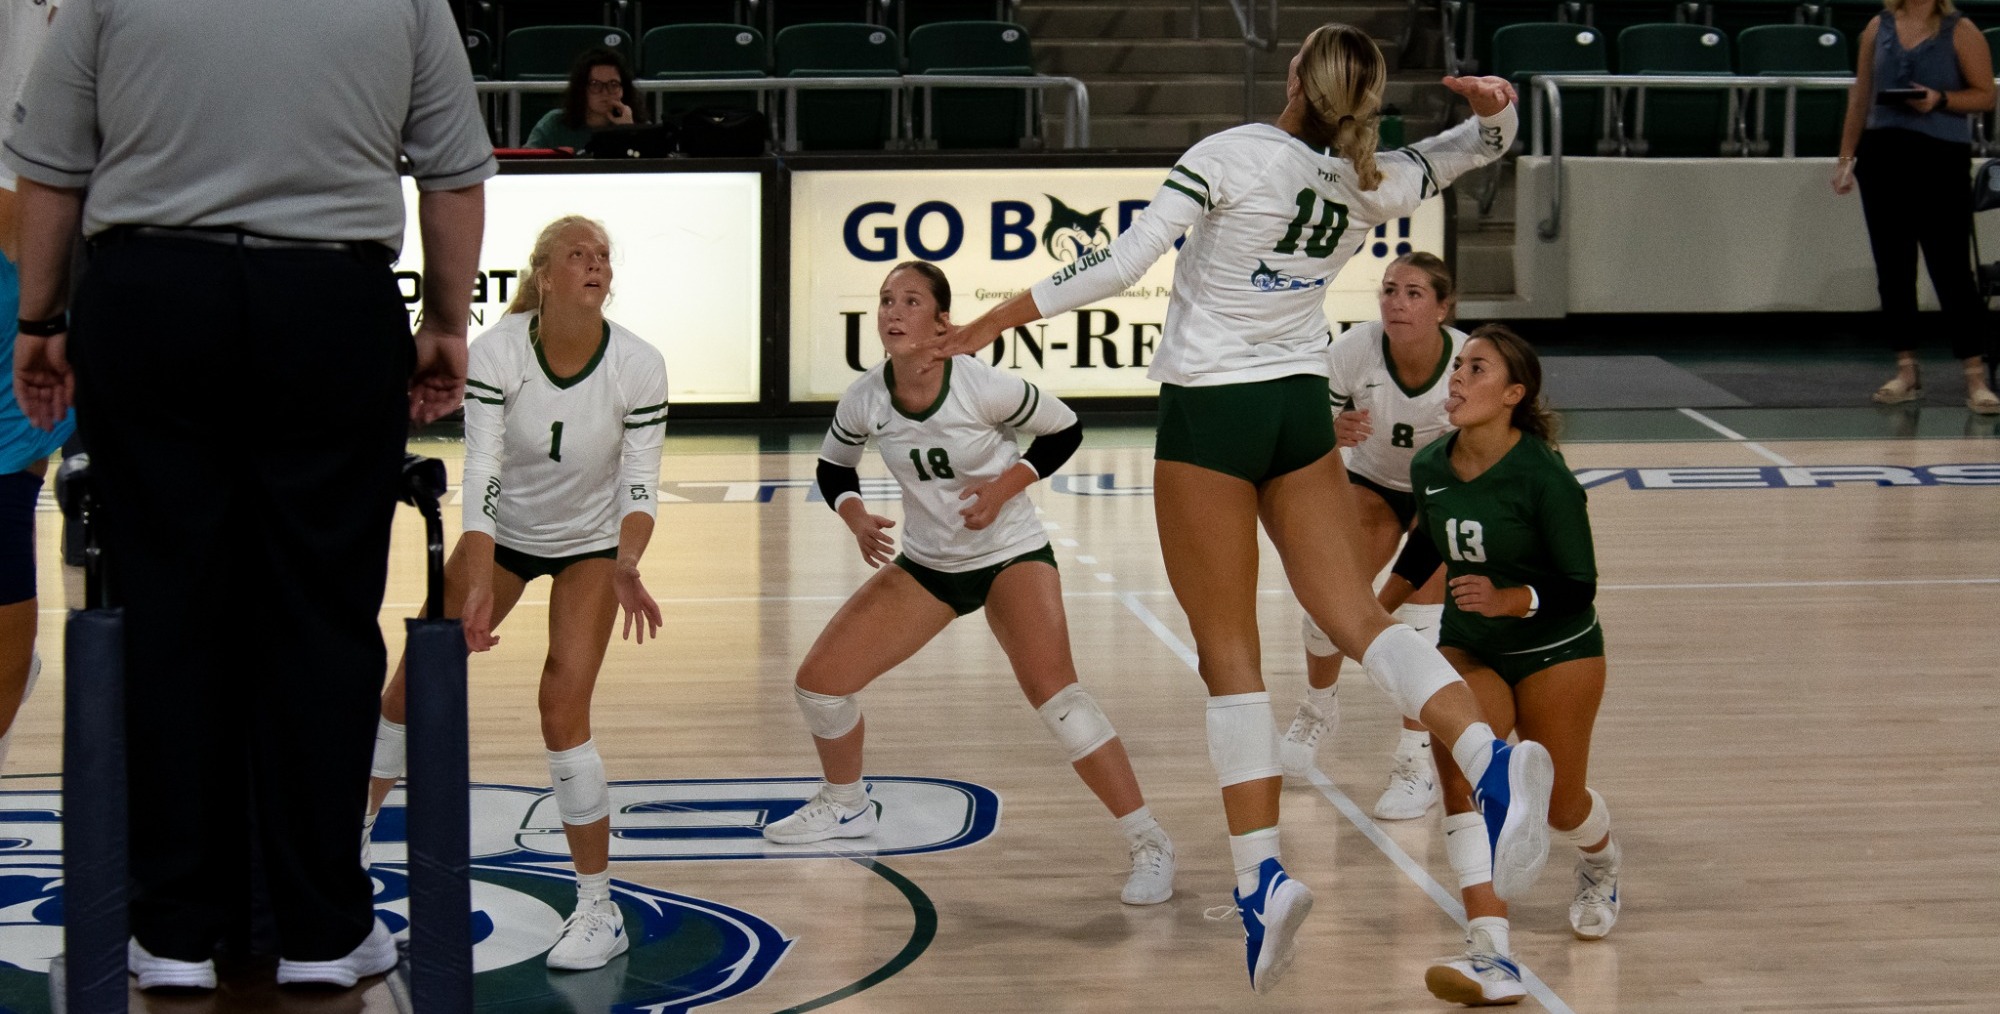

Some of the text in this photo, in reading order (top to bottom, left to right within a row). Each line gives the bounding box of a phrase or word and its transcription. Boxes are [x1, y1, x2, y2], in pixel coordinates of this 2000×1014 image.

[843, 200, 965, 262] GO
[1272, 187, 1349, 259] 10
[548, 420, 564, 463] 1
[1391, 422, 1414, 448] 8
[909, 447, 955, 482] 18
[1445, 517, 1487, 563] 13
